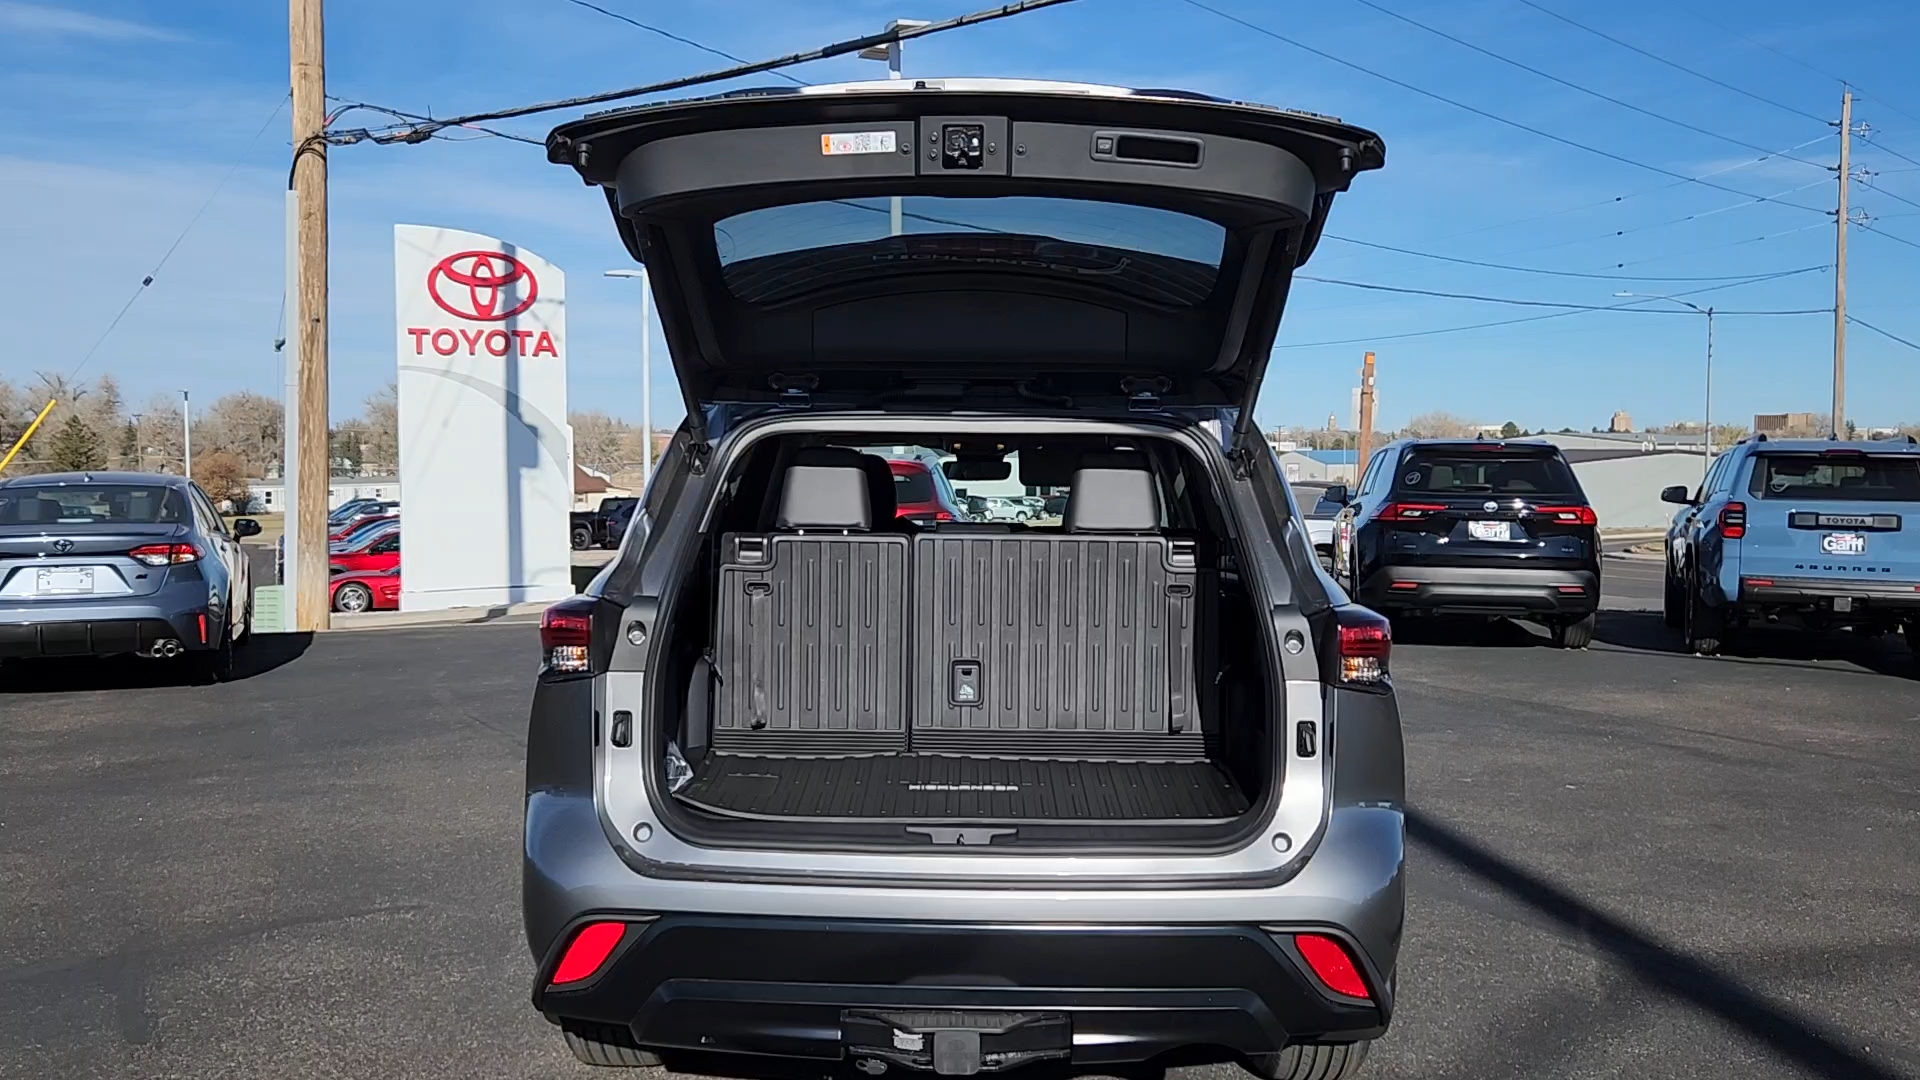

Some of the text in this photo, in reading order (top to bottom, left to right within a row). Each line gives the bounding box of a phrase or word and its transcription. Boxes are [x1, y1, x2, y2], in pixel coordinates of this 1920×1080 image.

[408, 328, 559, 357] TOYOTA
[1825, 517, 1867, 525] TOYOTA
[1823, 536, 1865, 552] Garff
[908, 784, 1019, 792] HIGHLANDER
